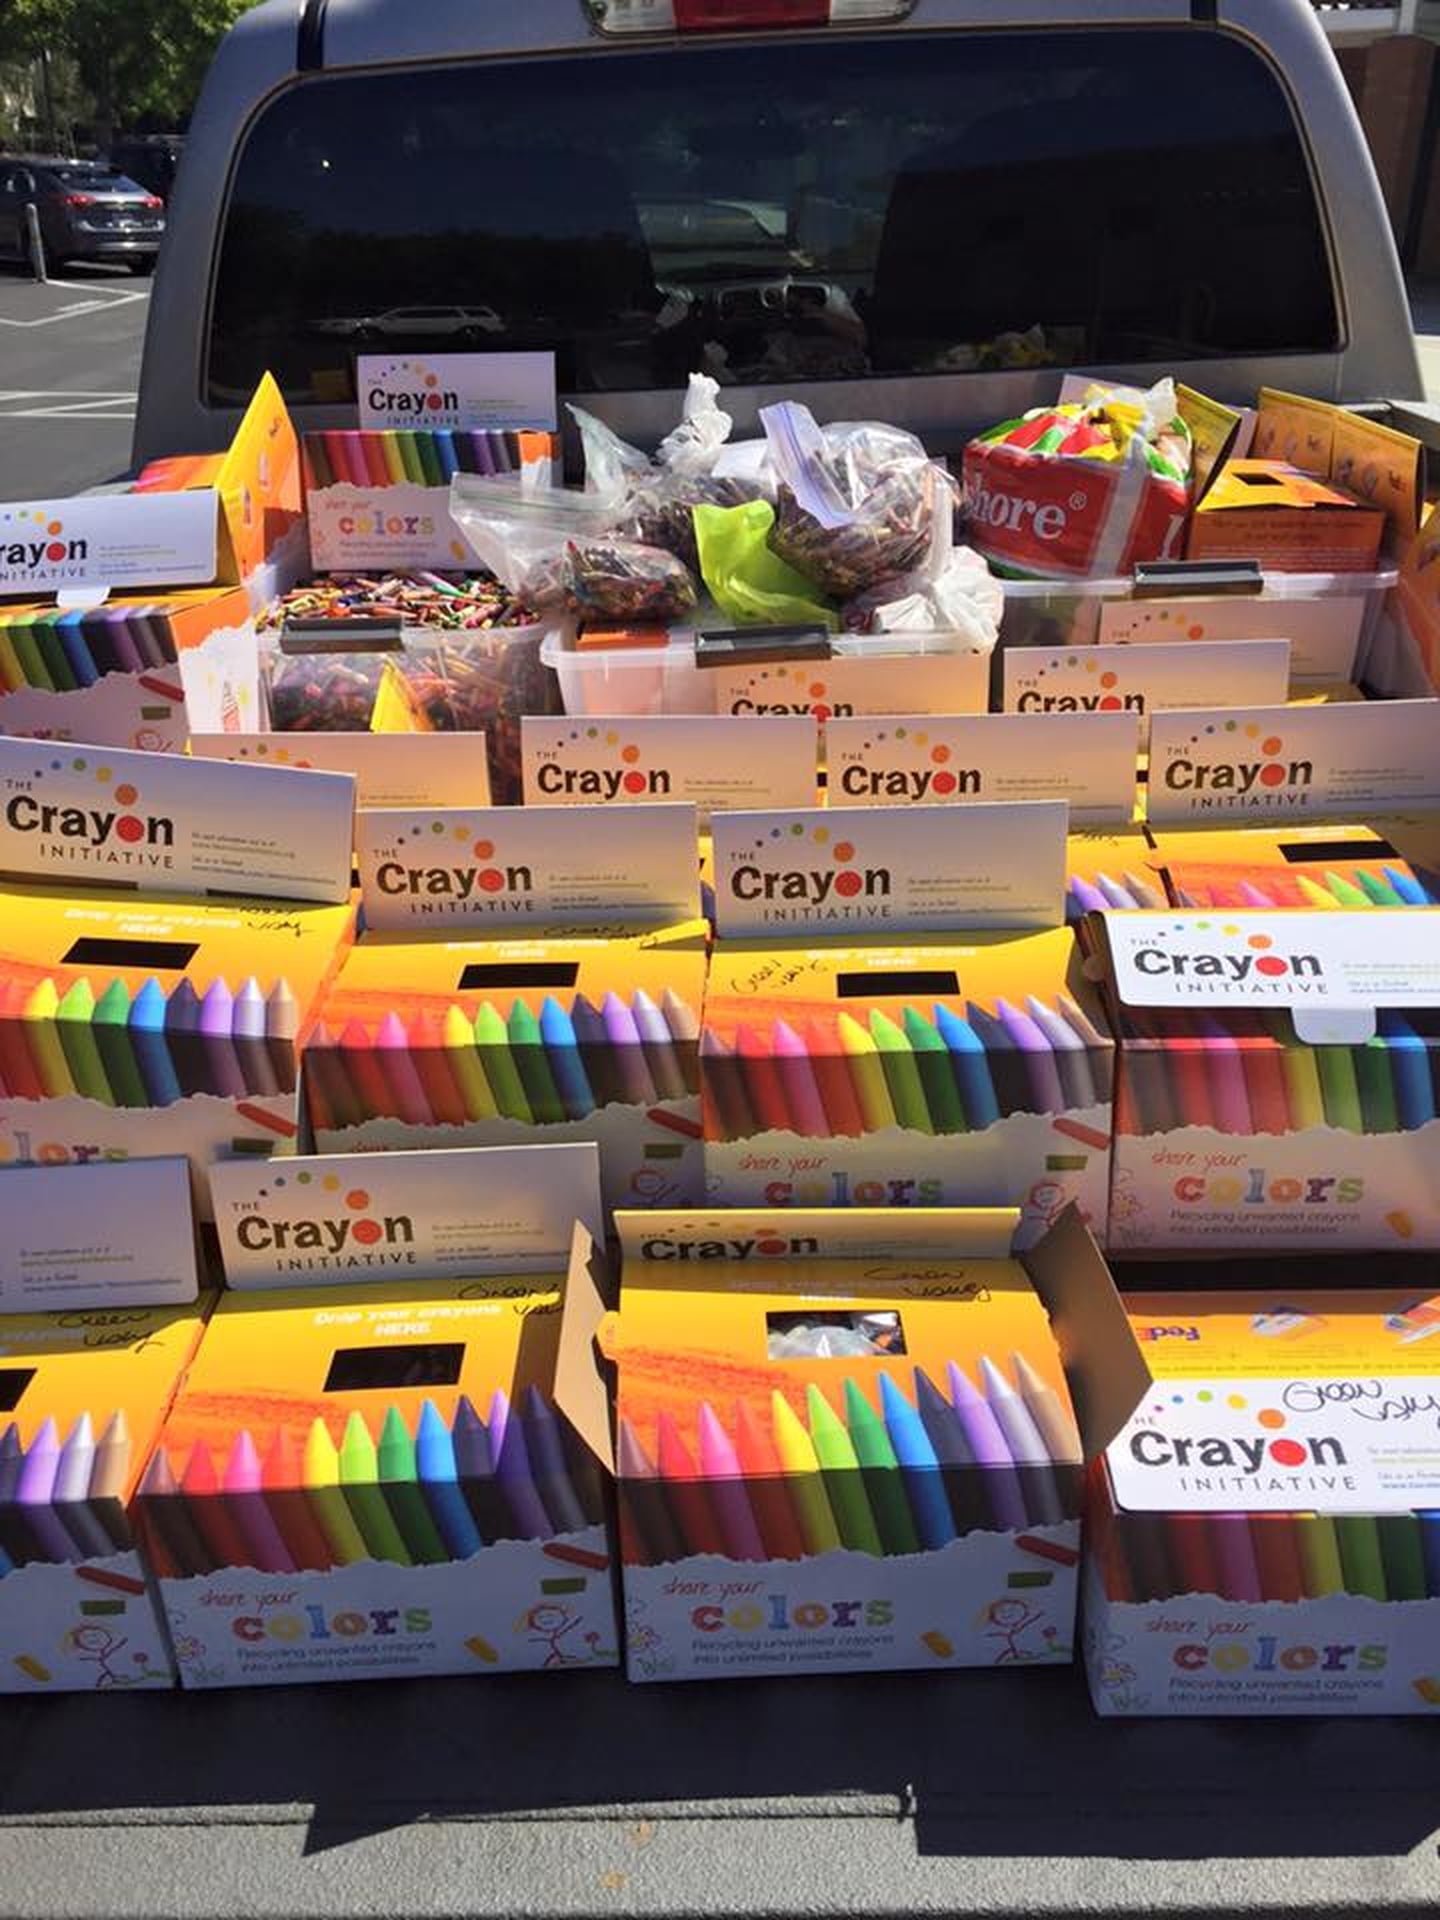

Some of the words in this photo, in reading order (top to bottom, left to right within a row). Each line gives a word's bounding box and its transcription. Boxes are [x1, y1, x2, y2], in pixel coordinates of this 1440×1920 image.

[369, 388, 458, 414] Crayon
[338, 511, 435, 535] colors
[6, 778, 32, 792] THE
[537, 763, 671, 799] Crayon
[842, 764, 981, 800] Crayon
[1165, 758, 1313, 793] Crayon
[1191, 793, 1308, 809] INITIATIVE
[6, 795, 174, 846] Crayon
[40, 843, 174, 870] INITIATIVE
[376, 862, 532, 899] Crayon
[731, 864, 891, 905] Crayon
[410, 899, 535, 914] INITIATIVE
[764, 905, 891, 921] INITIATIVE
[1133, 949, 1323, 981] Crayon
[1175, 982, 1328, 995] INITIATIVE
[764, 1171, 944, 1206] colors
[1173, 1168, 1365, 1204] colors
[232, 1201, 260, 1212] THE
[237, 1215, 414, 1253] Crayon
[641, 1237, 818, 1261] Crayon
[277, 1251, 417, 1272] INITIATIVE
[1130, 1430, 1348, 1475] Crayon
[1180, 1476, 1361, 1493] INITIATIVE
[231, 1604, 433, 1643] colors
[691, 1594, 895, 1632] colors
[1172, 1635, 1389, 1672] colors
